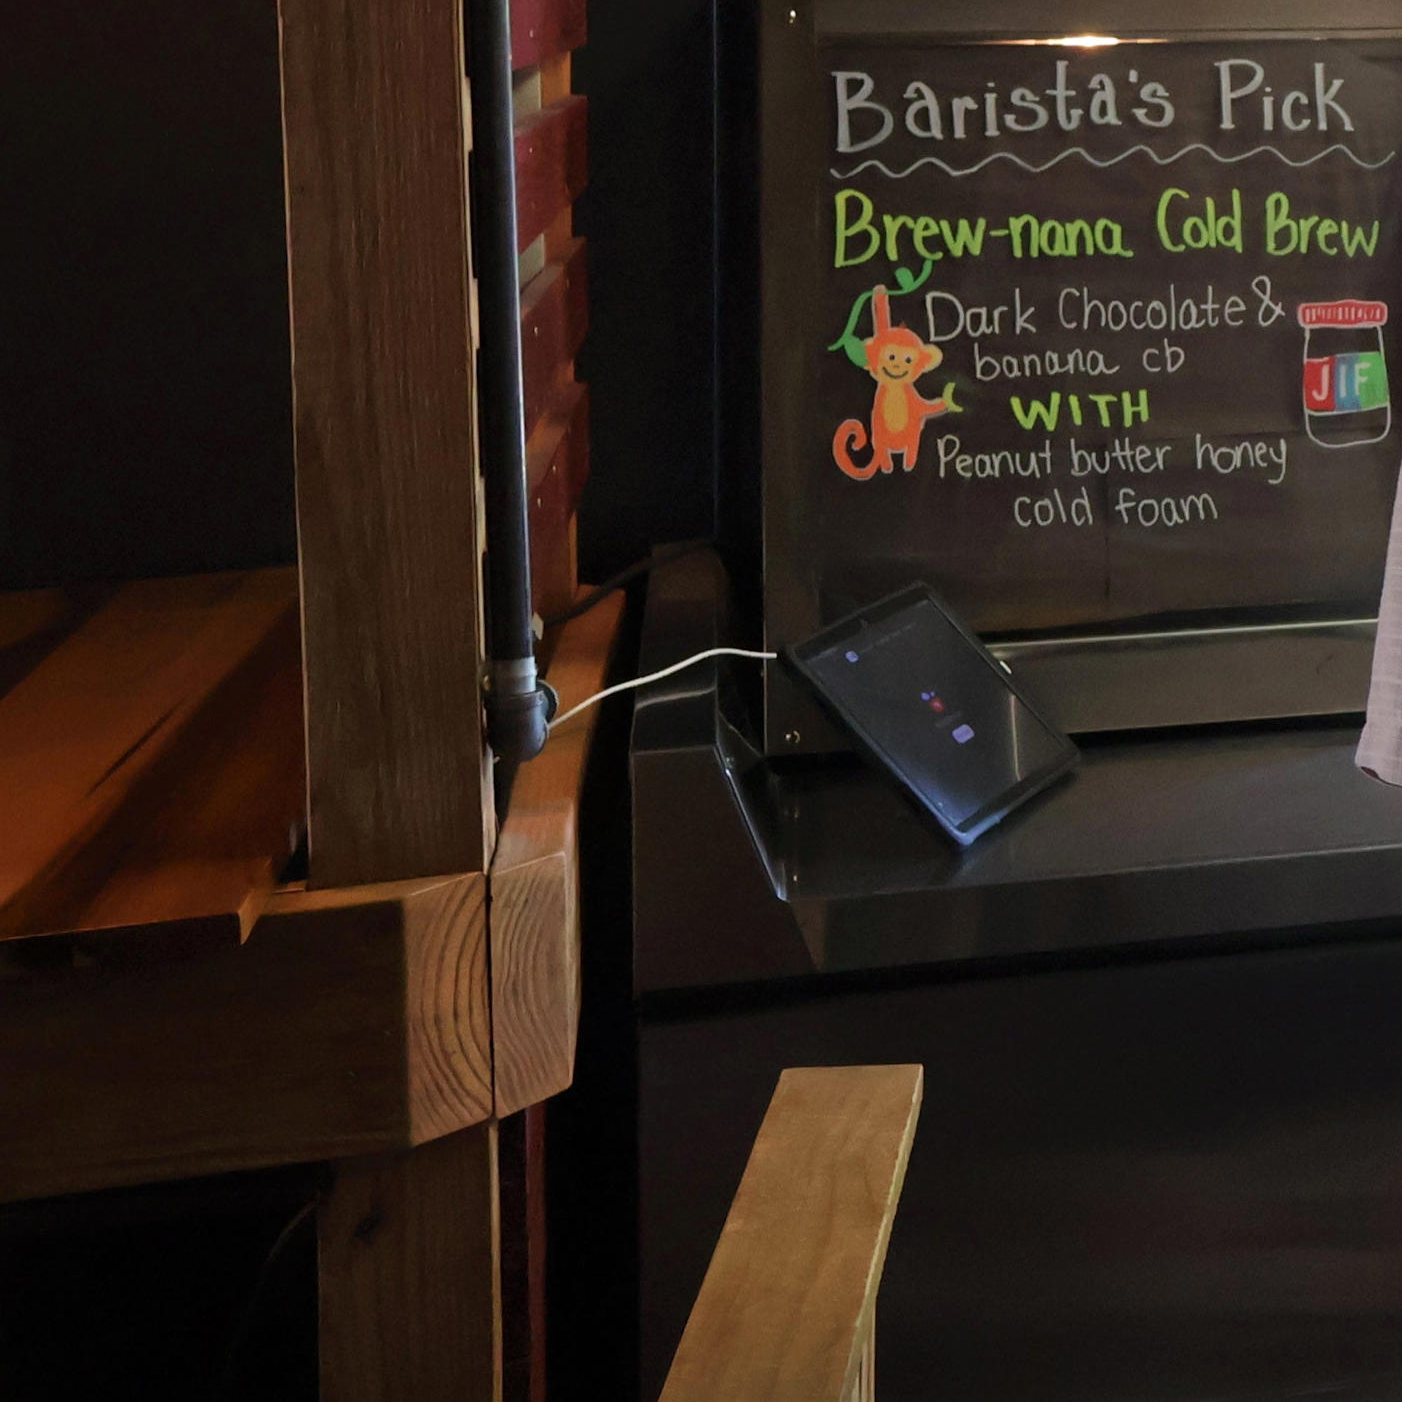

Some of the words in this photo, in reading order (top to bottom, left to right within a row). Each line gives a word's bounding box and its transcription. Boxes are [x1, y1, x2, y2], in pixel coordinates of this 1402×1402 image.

[830, 59, 1176, 155] Barista's
[1214, 58, 1355, 133] Pick
[833, 187, 1135, 269] Brew-nana
[1155, 187, 1243, 256] Cold
[1265, 191, 1381, 258] Brew
[924, 286, 1037, 343] Dark
[1058, 285, 1246, 333] Chocolate
[973, 341, 1119, 383] banana
[1142, 338, 1186, 375] cb
[1312, 360, 1372, 404] JIF
[1010, 389, 1150, 433] WITH
[936, 435, 1053, 481] Peanut
[1071, 437, 1173, 476] butter
[1195, 434, 1289, 485] honey
[1014, 488, 1093, 528] cold
[1115, 489, 1219, 527] foam
